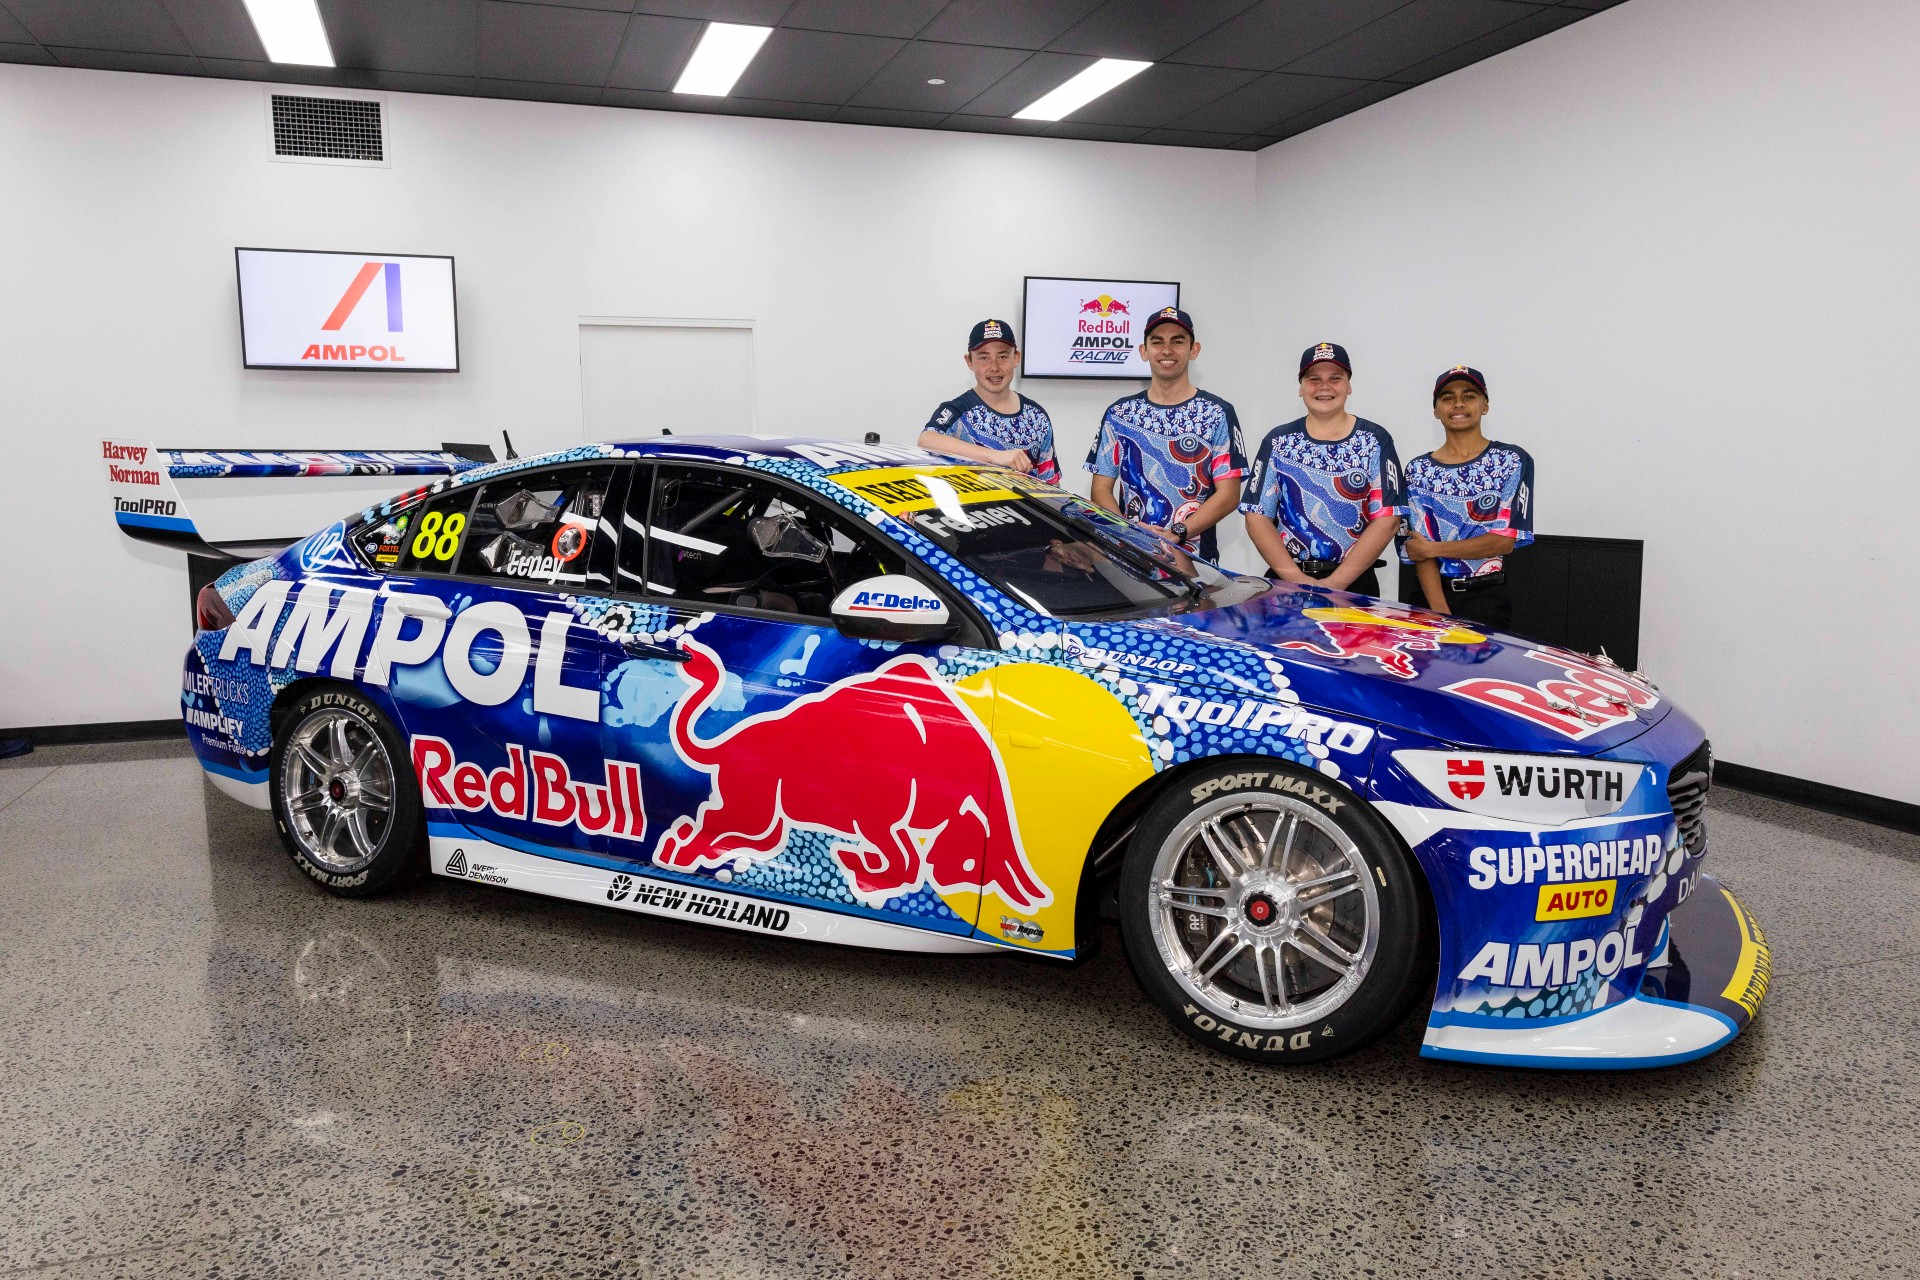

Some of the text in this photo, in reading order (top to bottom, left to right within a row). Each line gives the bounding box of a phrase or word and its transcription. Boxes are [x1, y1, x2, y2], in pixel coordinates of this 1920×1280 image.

[1078, 320, 1130, 334] Red Bull
[301, 344, 405, 361] AMPOL
[1072, 336, 1133, 348] AMPOL
[1070, 351, 1130, 361] RACING
[102, 441, 148, 465] Harvey
[109, 465, 160, 485] Norman
[854, 473, 1002, 504] NATNAL
[113, 497, 177, 516] ToolPRO
[379, 545, 400, 553] FOXTEL
[412, 511, 465, 561] 88
[853, 591, 941, 610] ACDelco
[218, 579, 600, 722] AMPOL
[1086, 647, 1196, 674] DUNLOP
[1439, 649, 1660, 741] Red
[193, 710, 243, 737] AMPLIFY
[1138, 682, 1375, 754] ToolPRO
[201, 733, 228, 750] Premium
[411, 736, 526, 818] Red
[532, 753, 646, 840] Bull
[1190, 772, 1346, 815] SPORT MAXX
[1494, 764, 1623, 802] WÜRTH
[1468, 834, 1662, 891] SUPERCHEAP
[468, 871, 509, 884] DENNISON
[633, 883, 790, 932] NEW HOLLAND
[1546, 888, 1608, 912] AUTO
[1458, 926, 1643, 988] AMPOL
